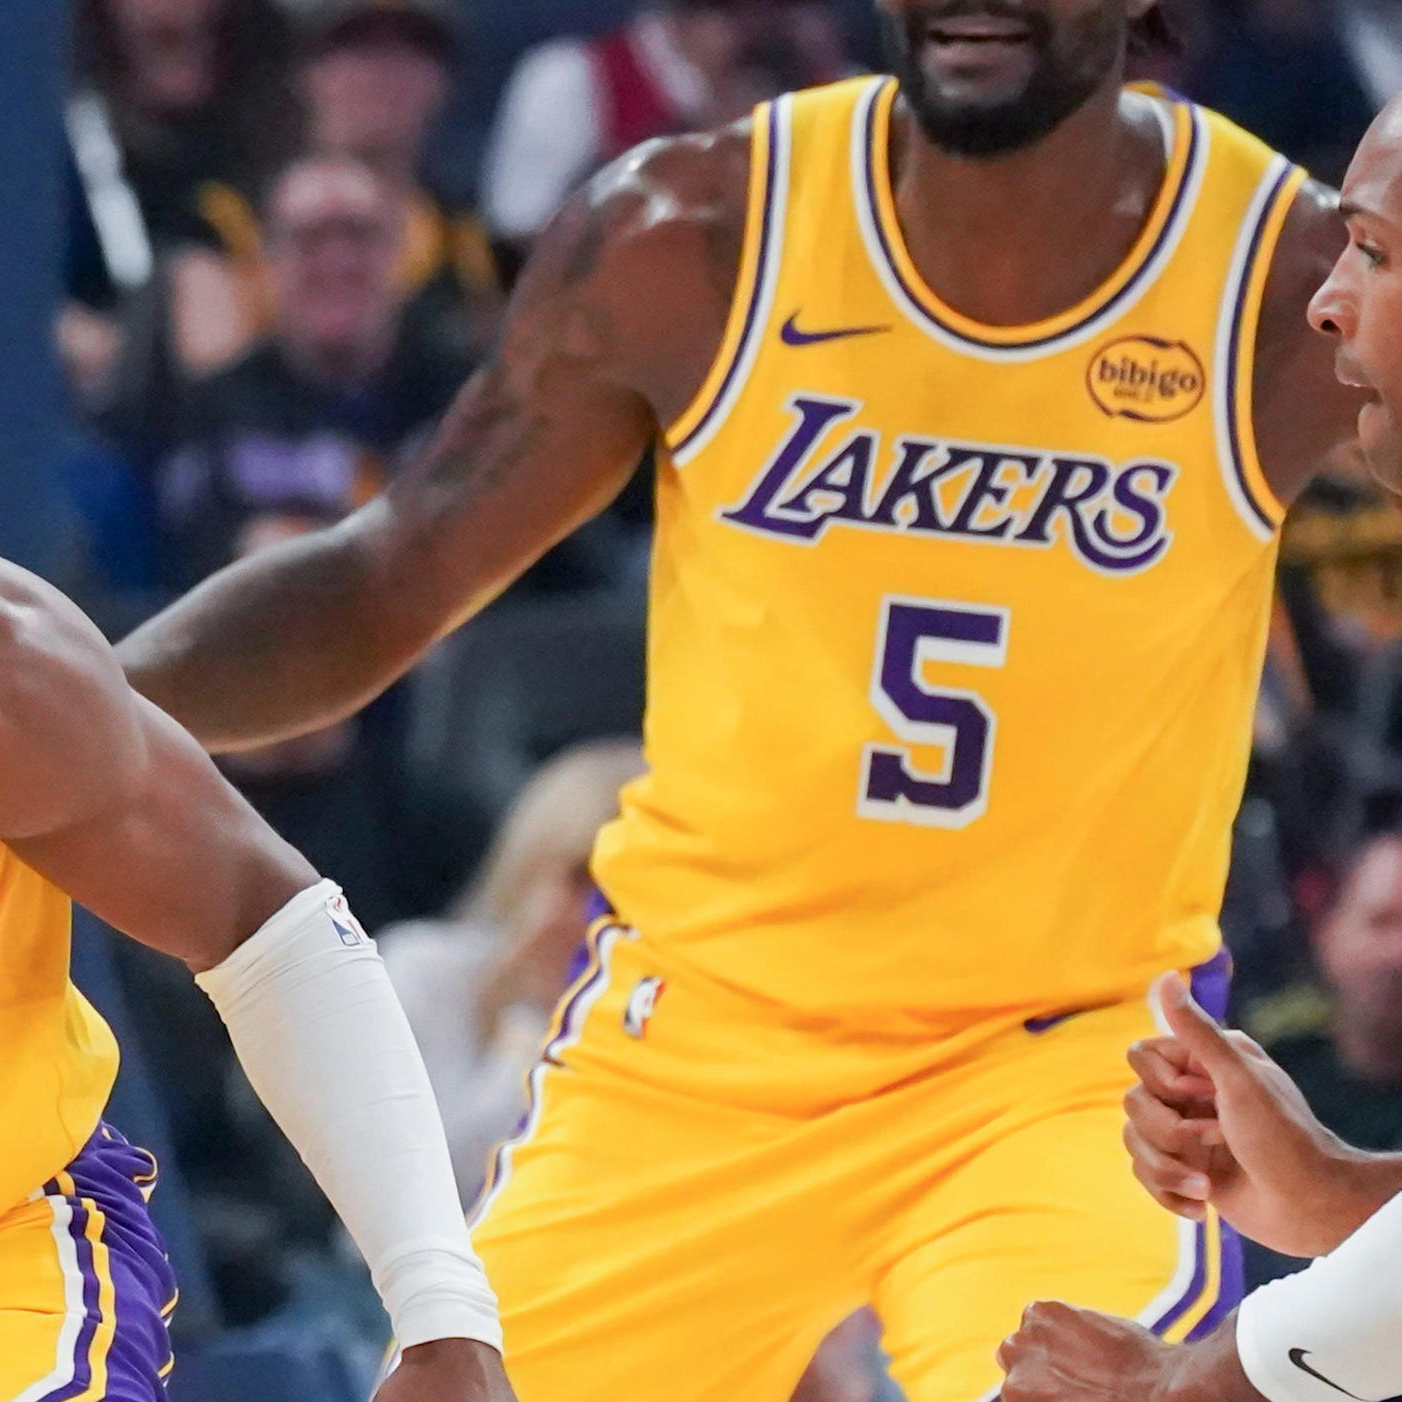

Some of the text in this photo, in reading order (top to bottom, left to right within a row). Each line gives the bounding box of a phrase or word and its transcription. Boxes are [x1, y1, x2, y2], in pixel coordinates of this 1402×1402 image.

[1099, 356, 1196, 398] bibigo
[715, 391, 1180, 578] LAKERS
[856, 593, 1011, 830] 5
